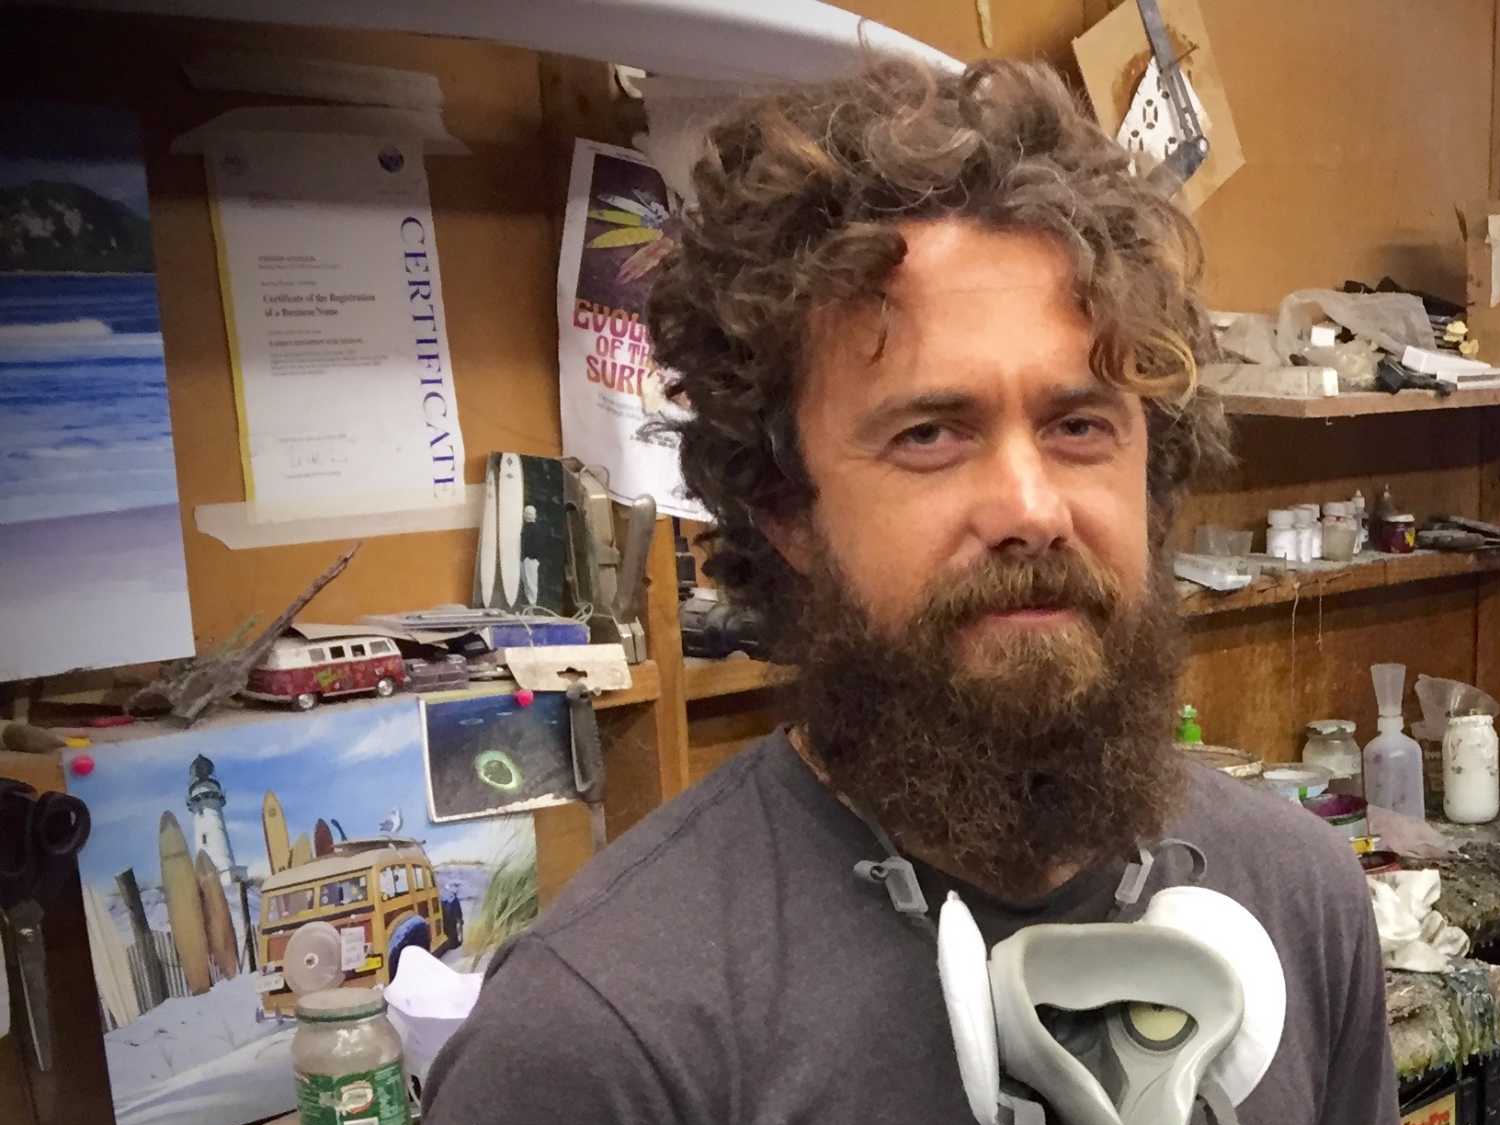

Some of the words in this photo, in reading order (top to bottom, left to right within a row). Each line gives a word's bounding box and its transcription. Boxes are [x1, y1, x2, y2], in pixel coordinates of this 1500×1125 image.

[401, 216, 455, 498] CERTIFICATE
[596, 335, 623, 361] OF
[628, 342, 649, 366] TH
